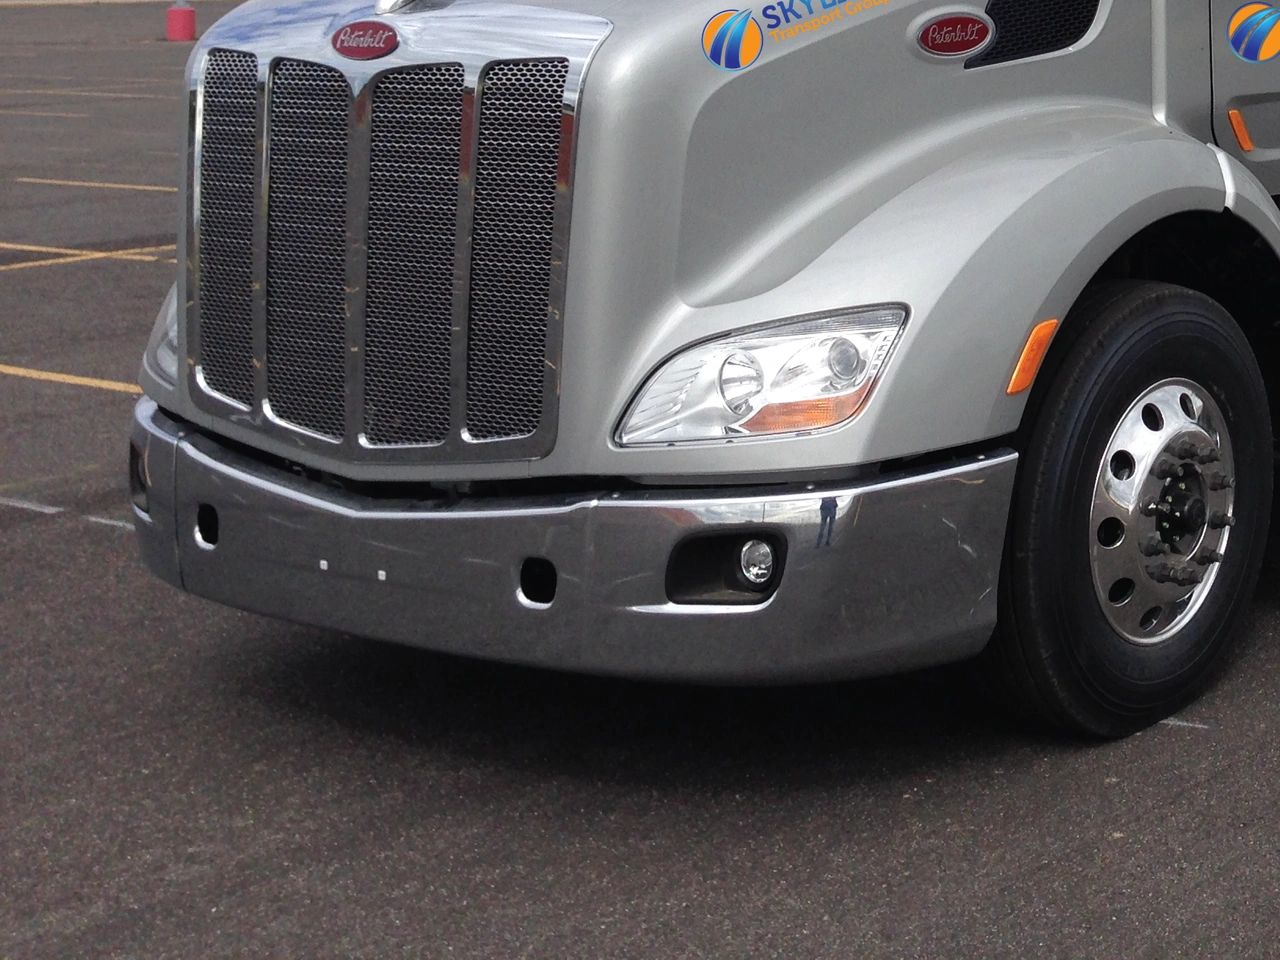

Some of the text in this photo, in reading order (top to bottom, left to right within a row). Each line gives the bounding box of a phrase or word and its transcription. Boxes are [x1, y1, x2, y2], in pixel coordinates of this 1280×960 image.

[768, 8, 844, 43] Transport
[928, 23, 983, 47] Peterbilt
[336, 27, 393, 49] Peterbilt
